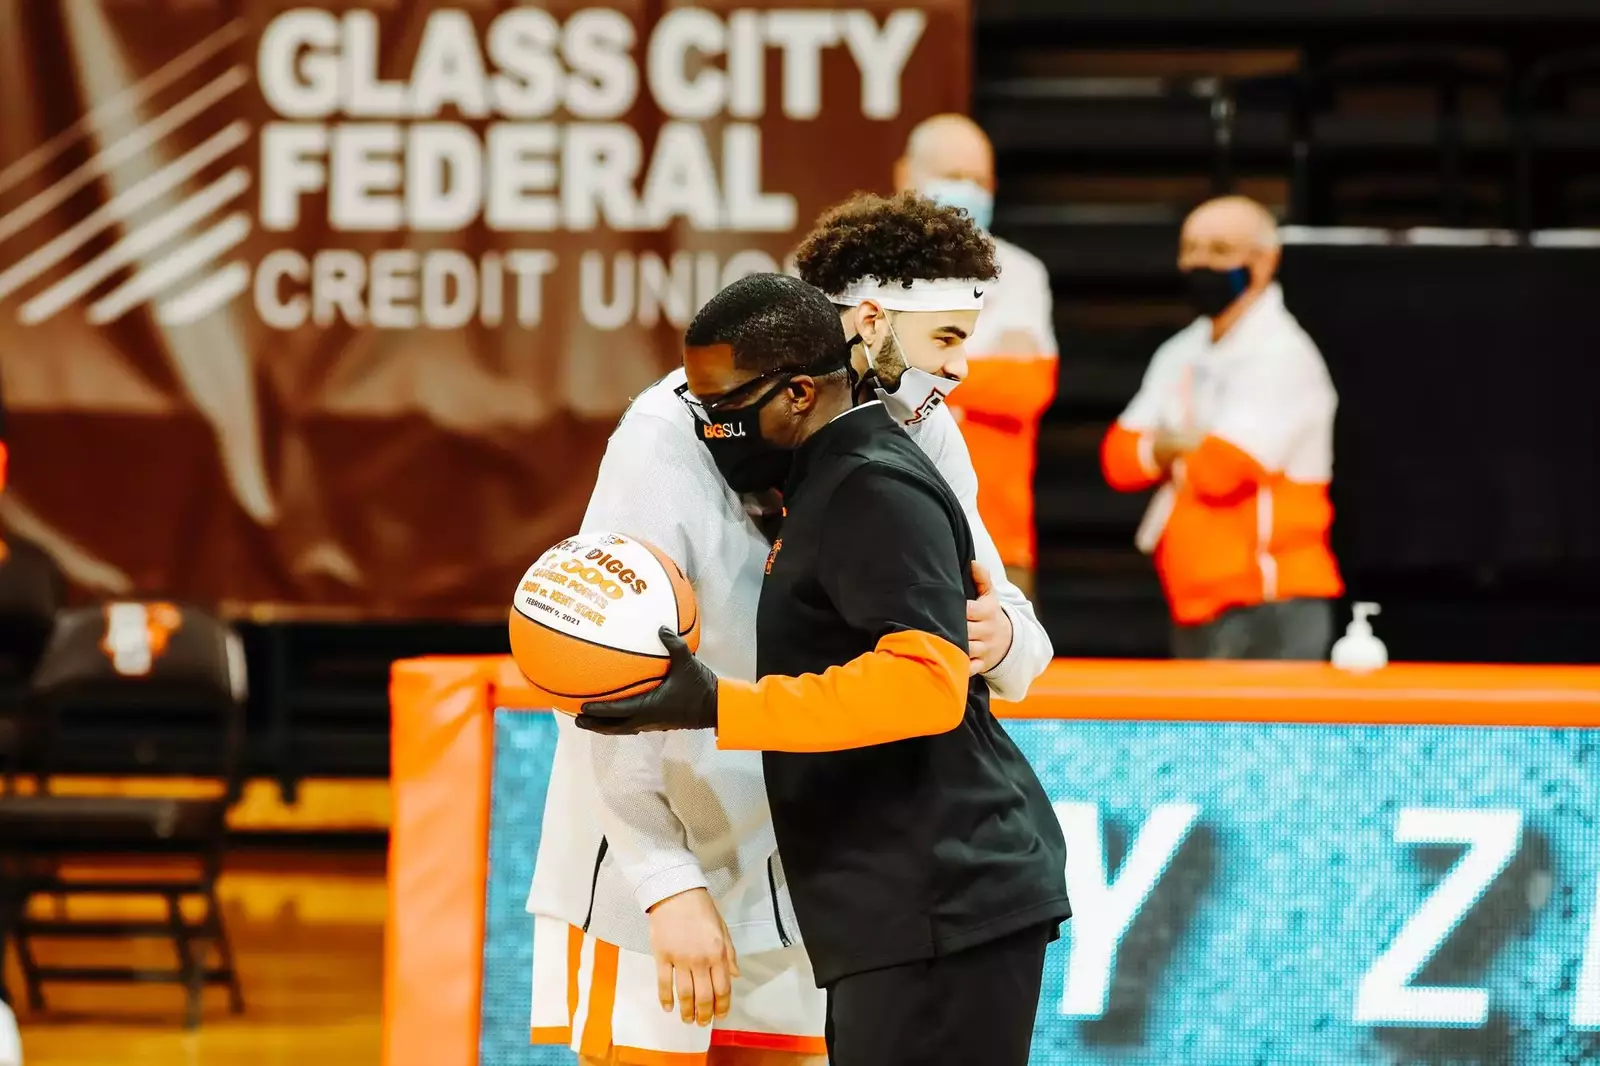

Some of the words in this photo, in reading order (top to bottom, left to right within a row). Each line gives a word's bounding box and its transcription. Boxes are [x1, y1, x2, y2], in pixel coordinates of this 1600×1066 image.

[257, 8, 640, 119] GLASS
[646, 8, 927, 119] CITY
[259, 122, 796, 231] FEDERAL
[254, 249, 556, 330] CREDIT
[580, 249, 801, 329] UNI
[585, 548, 648, 594] DIGGS
[525, 597, 556, 614] FEBRUARY
[562, 613, 581, 626] 2021
[574, 601, 606, 627] STATE
